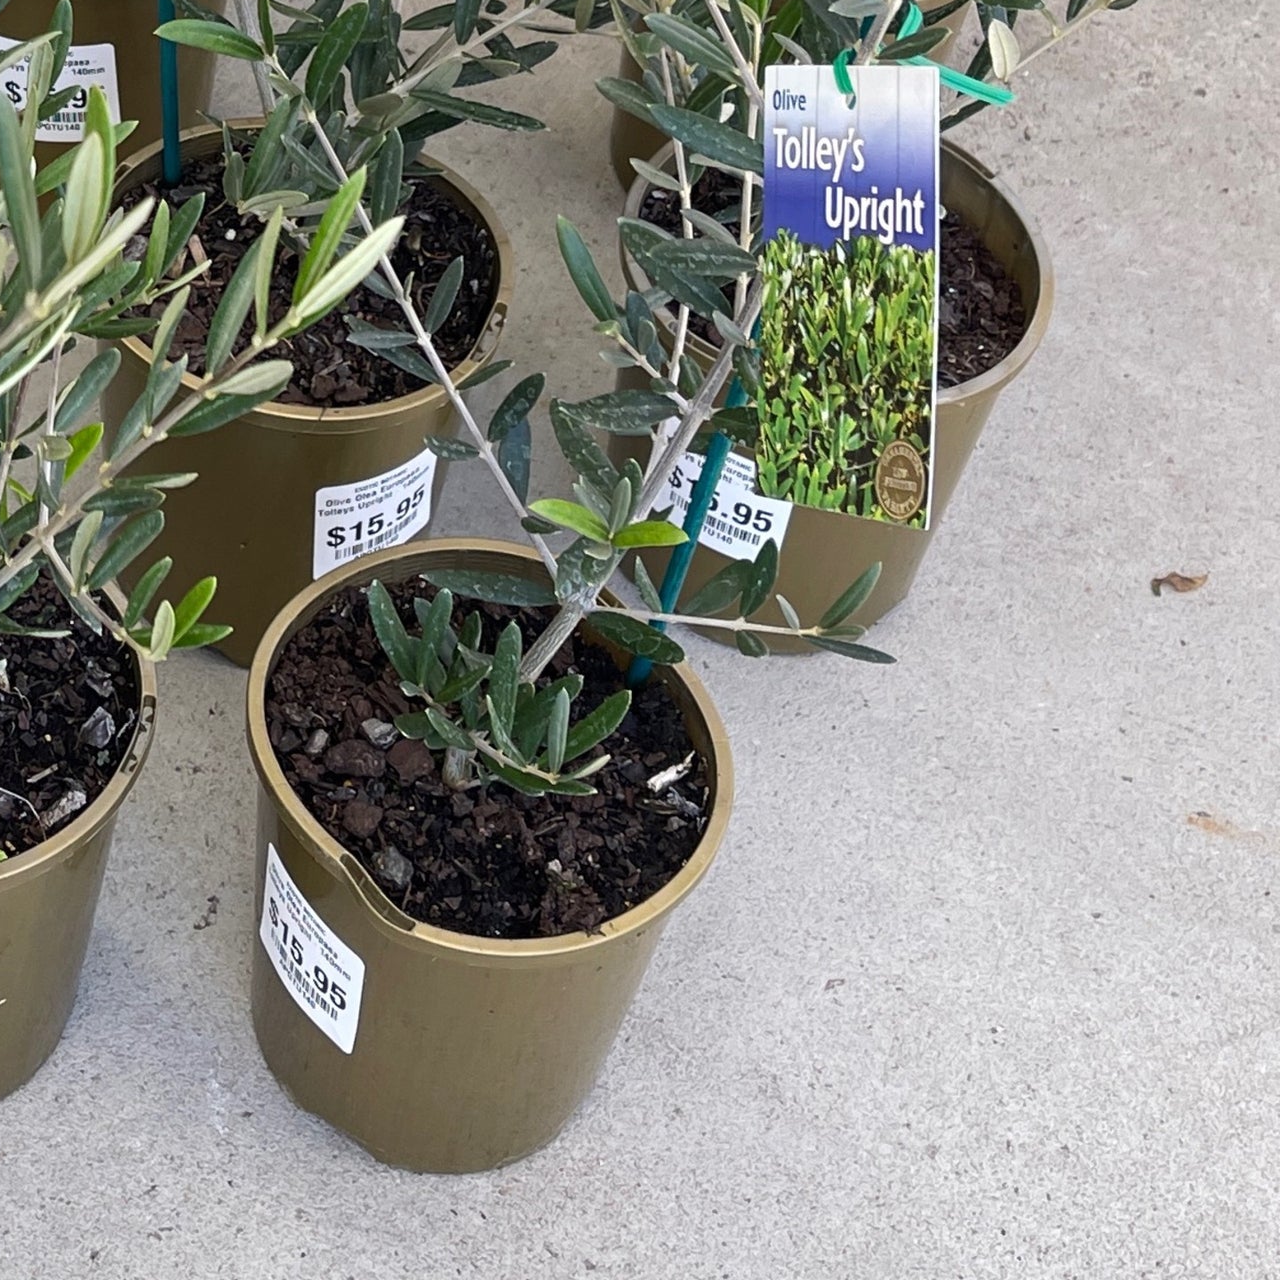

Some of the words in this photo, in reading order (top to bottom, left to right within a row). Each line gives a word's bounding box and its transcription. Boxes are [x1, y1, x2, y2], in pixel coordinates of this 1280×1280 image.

[772, 89, 807, 111] Olive
[37, 122, 80, 131] GTU140
[773, 126, 865, 183] Tolley's
[824, 186, 925, 245] Upright
[726, 457, 752, 472] OTANIC
[355, 490, 377, 501] Olea
[326, 483, 425, 548] $15.95
[702, 526, 733, 545] TU140
[269, 897, 346, 1011] $15.95
